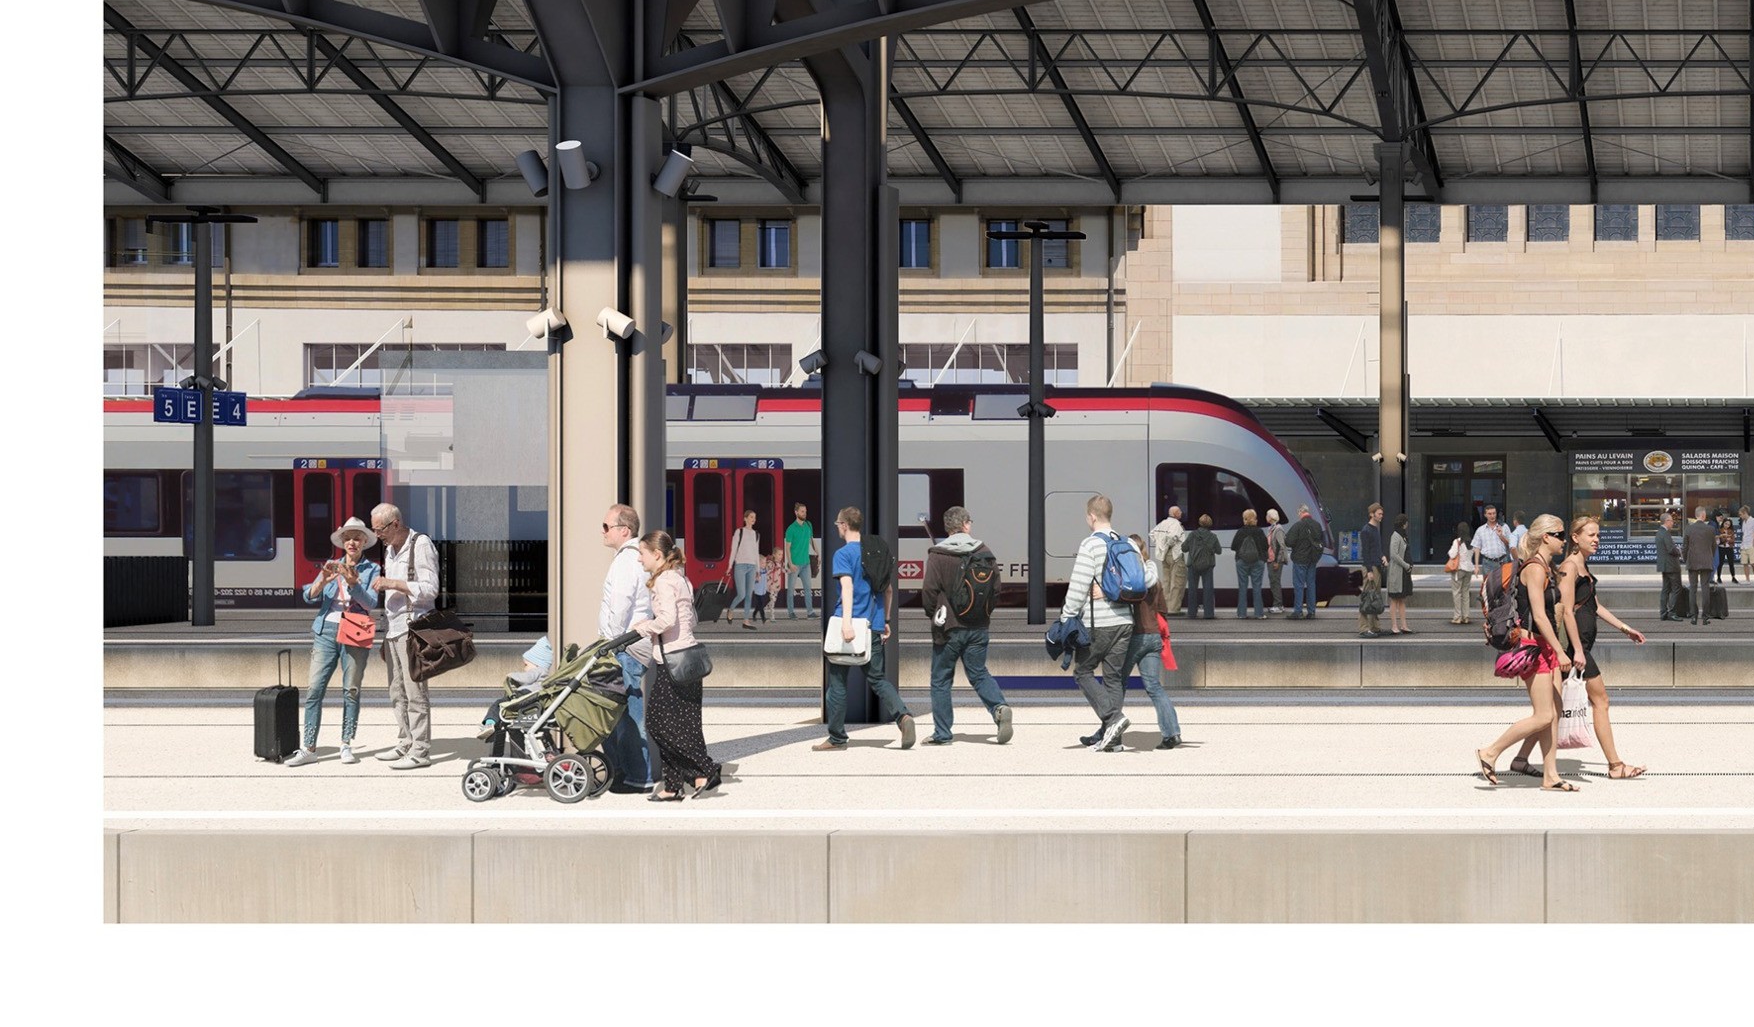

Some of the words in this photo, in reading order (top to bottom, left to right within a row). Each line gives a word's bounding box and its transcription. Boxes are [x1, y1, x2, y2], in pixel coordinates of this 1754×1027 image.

[164, 399, 174, 417] 5
[187, 401, 196, 418] E
[232, 403, 241, 420] 4
[301, 459, 308, 469] 2
[376, 459, 384, 469] 2
[692, 459, 699, 469] 2
[768, 459, 775, 469] 2
